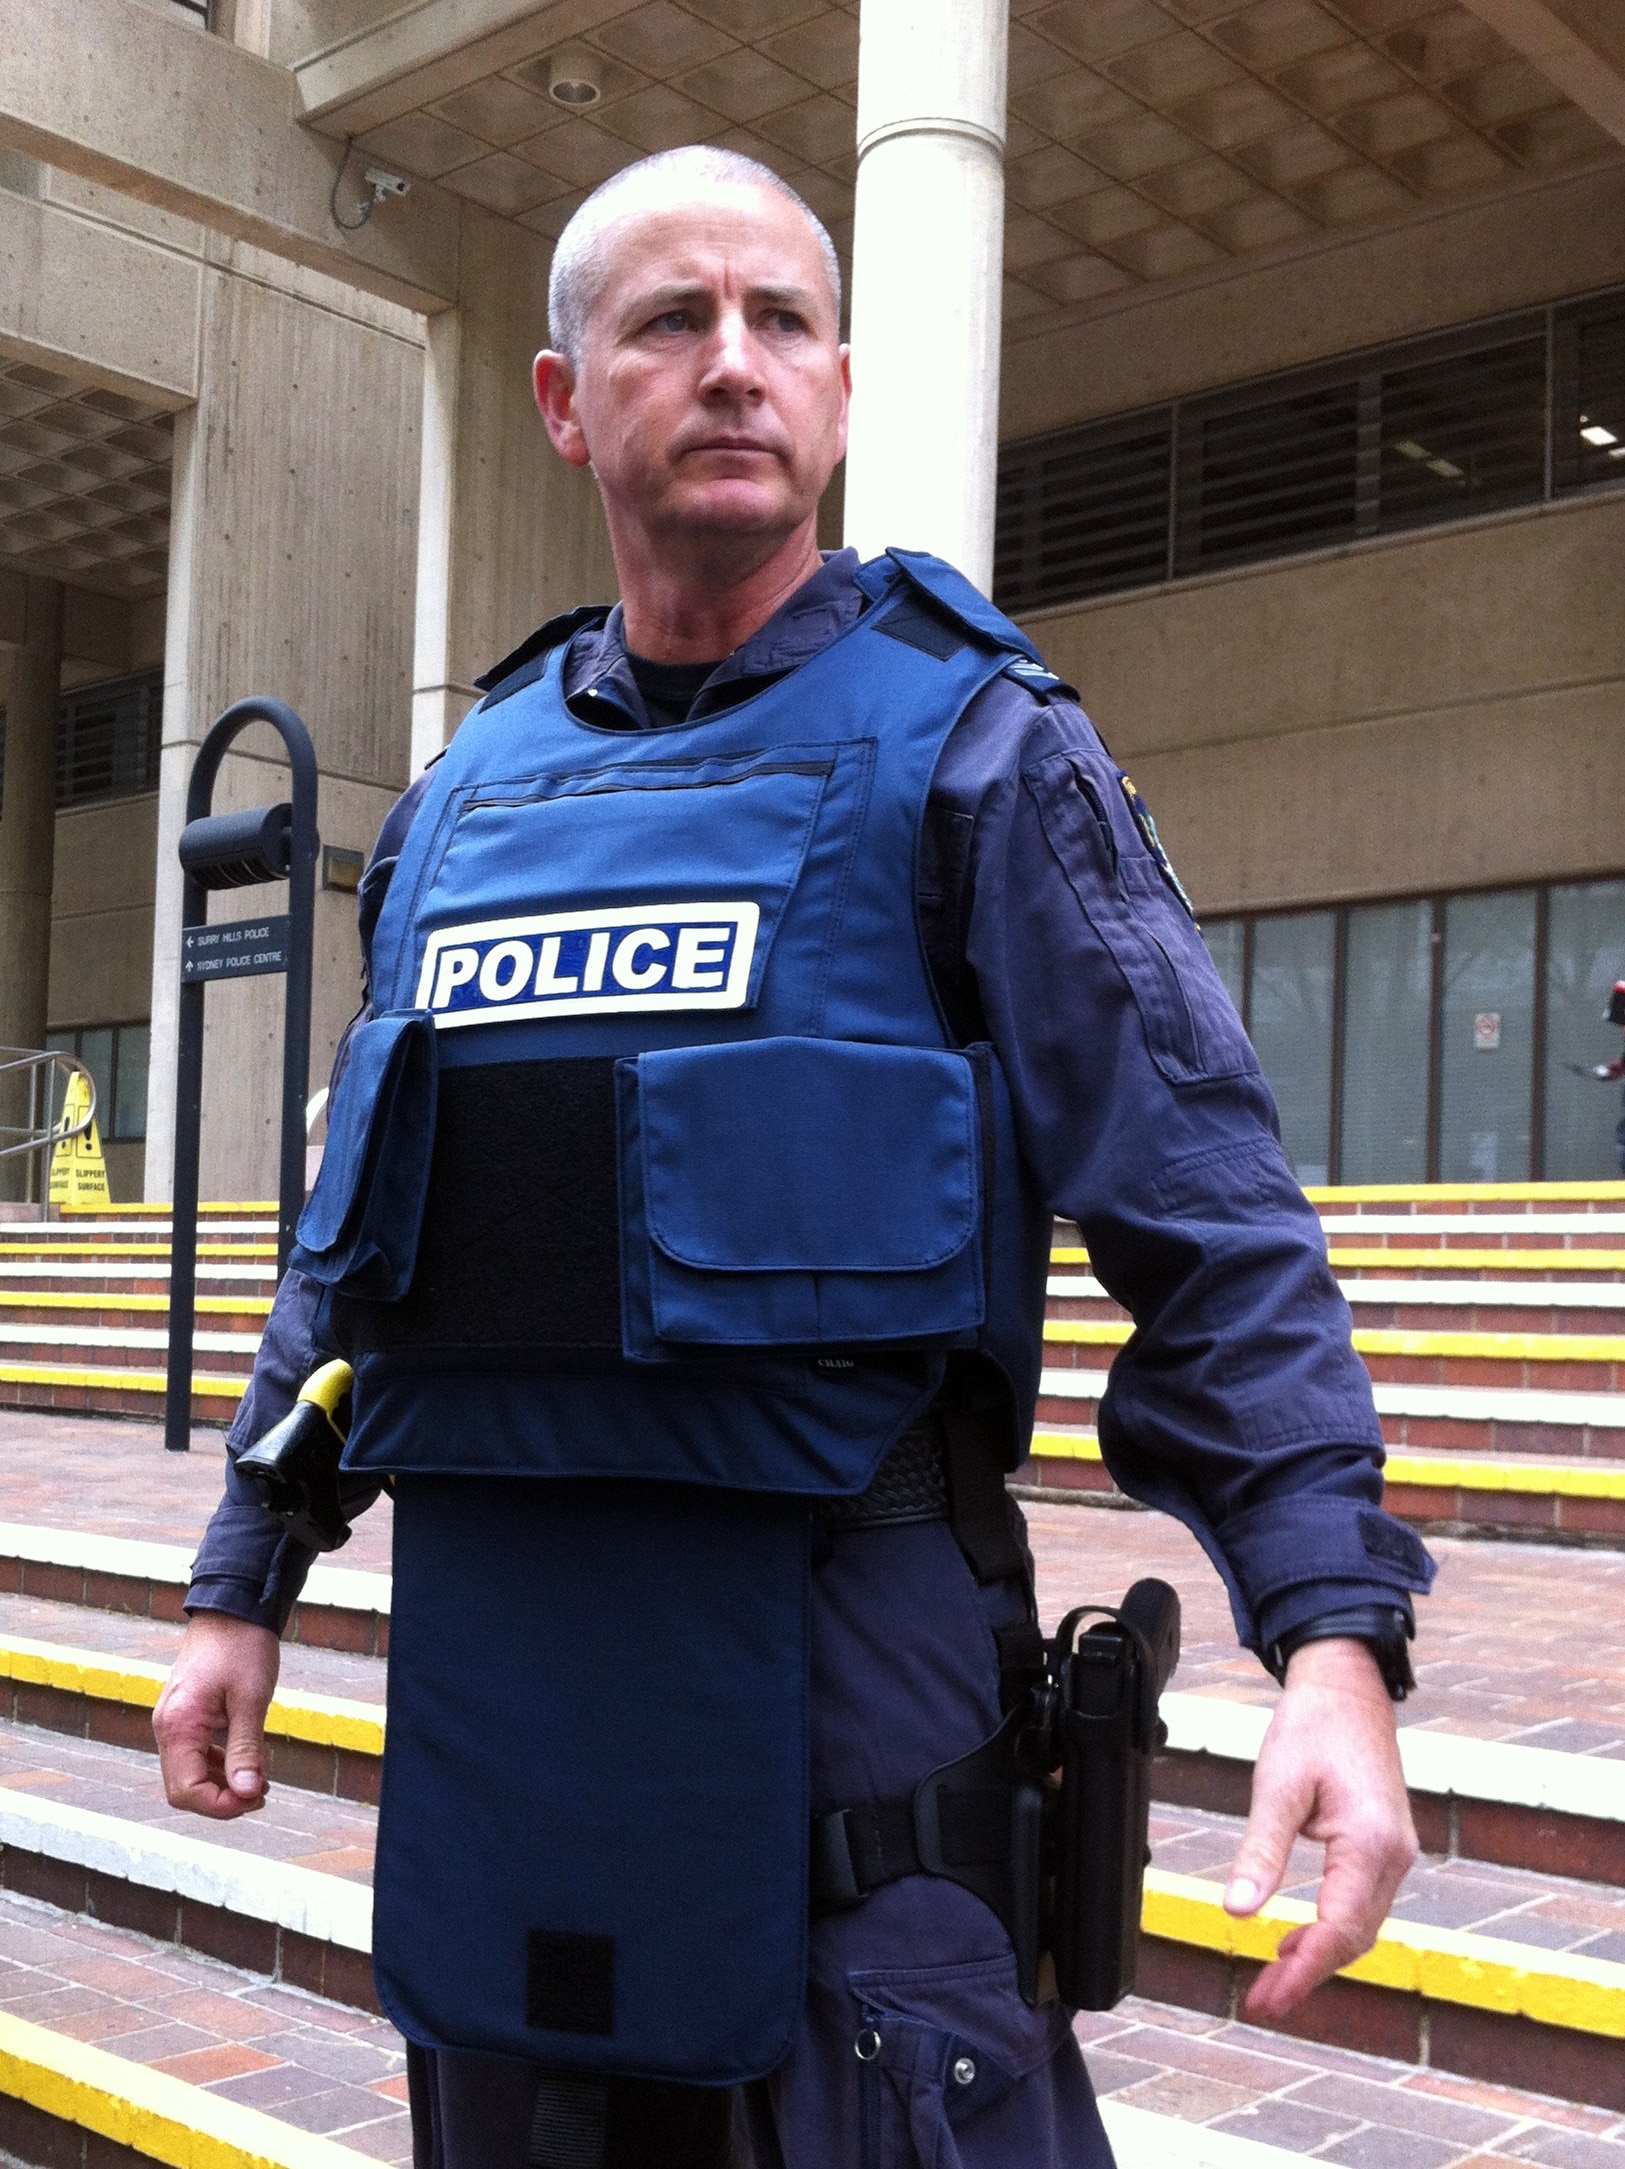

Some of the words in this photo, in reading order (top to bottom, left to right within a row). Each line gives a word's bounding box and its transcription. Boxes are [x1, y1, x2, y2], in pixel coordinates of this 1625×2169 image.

[197, 934, 220, 947] SURRY
[222, 931, 242, 943] HILLS
[244, 927, 270, 939] POLICE
[197, 959, 223, 971] SYDNEY
[226, 955, 251, 968] POLICE
[254, 951, 282, 964] CENTRE
[432, 926, 730, 1008] POLICE
[76, 1169, 105, 1178] SLIPPERY
[78, 1182, 105, 1191] SURFACE
